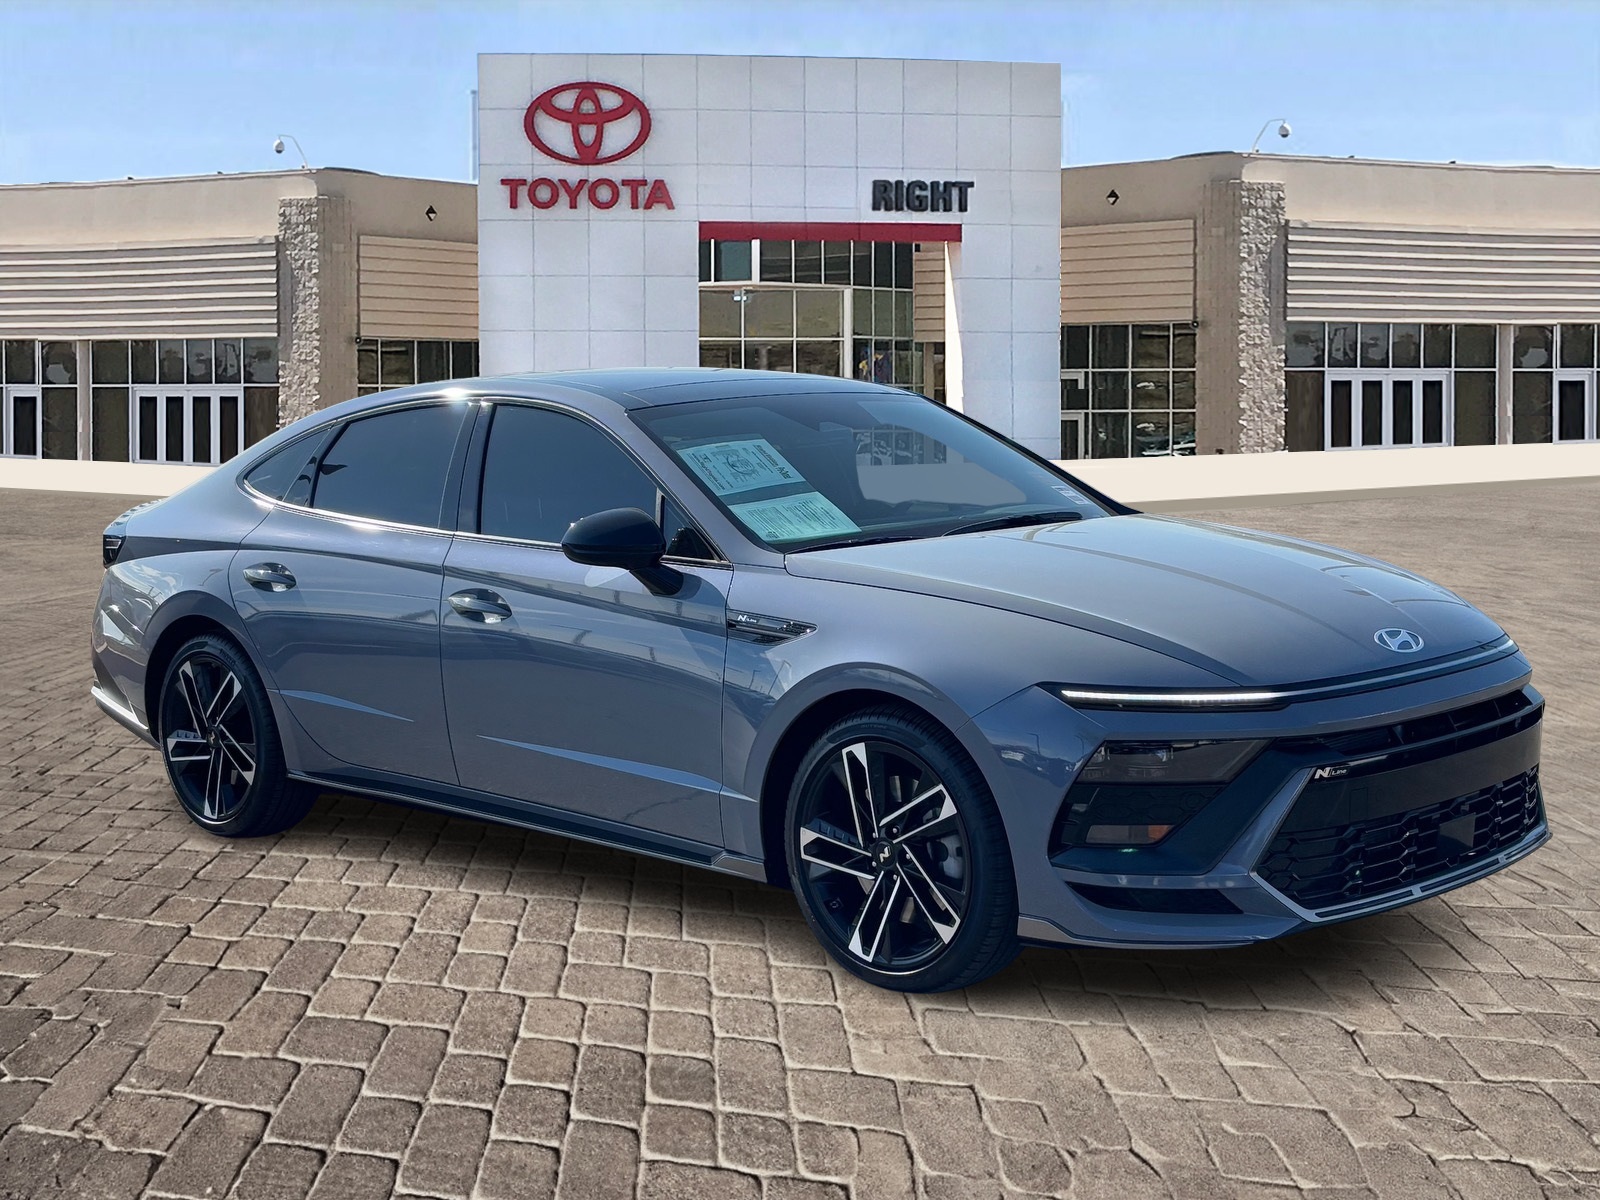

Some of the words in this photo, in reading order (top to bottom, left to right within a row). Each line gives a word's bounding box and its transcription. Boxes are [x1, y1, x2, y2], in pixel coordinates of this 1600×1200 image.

[500, 178, 675, 209] TOYOTA
[872, 179, 975, 212] RIGHT
[1314, 766, 1331, 779] N
